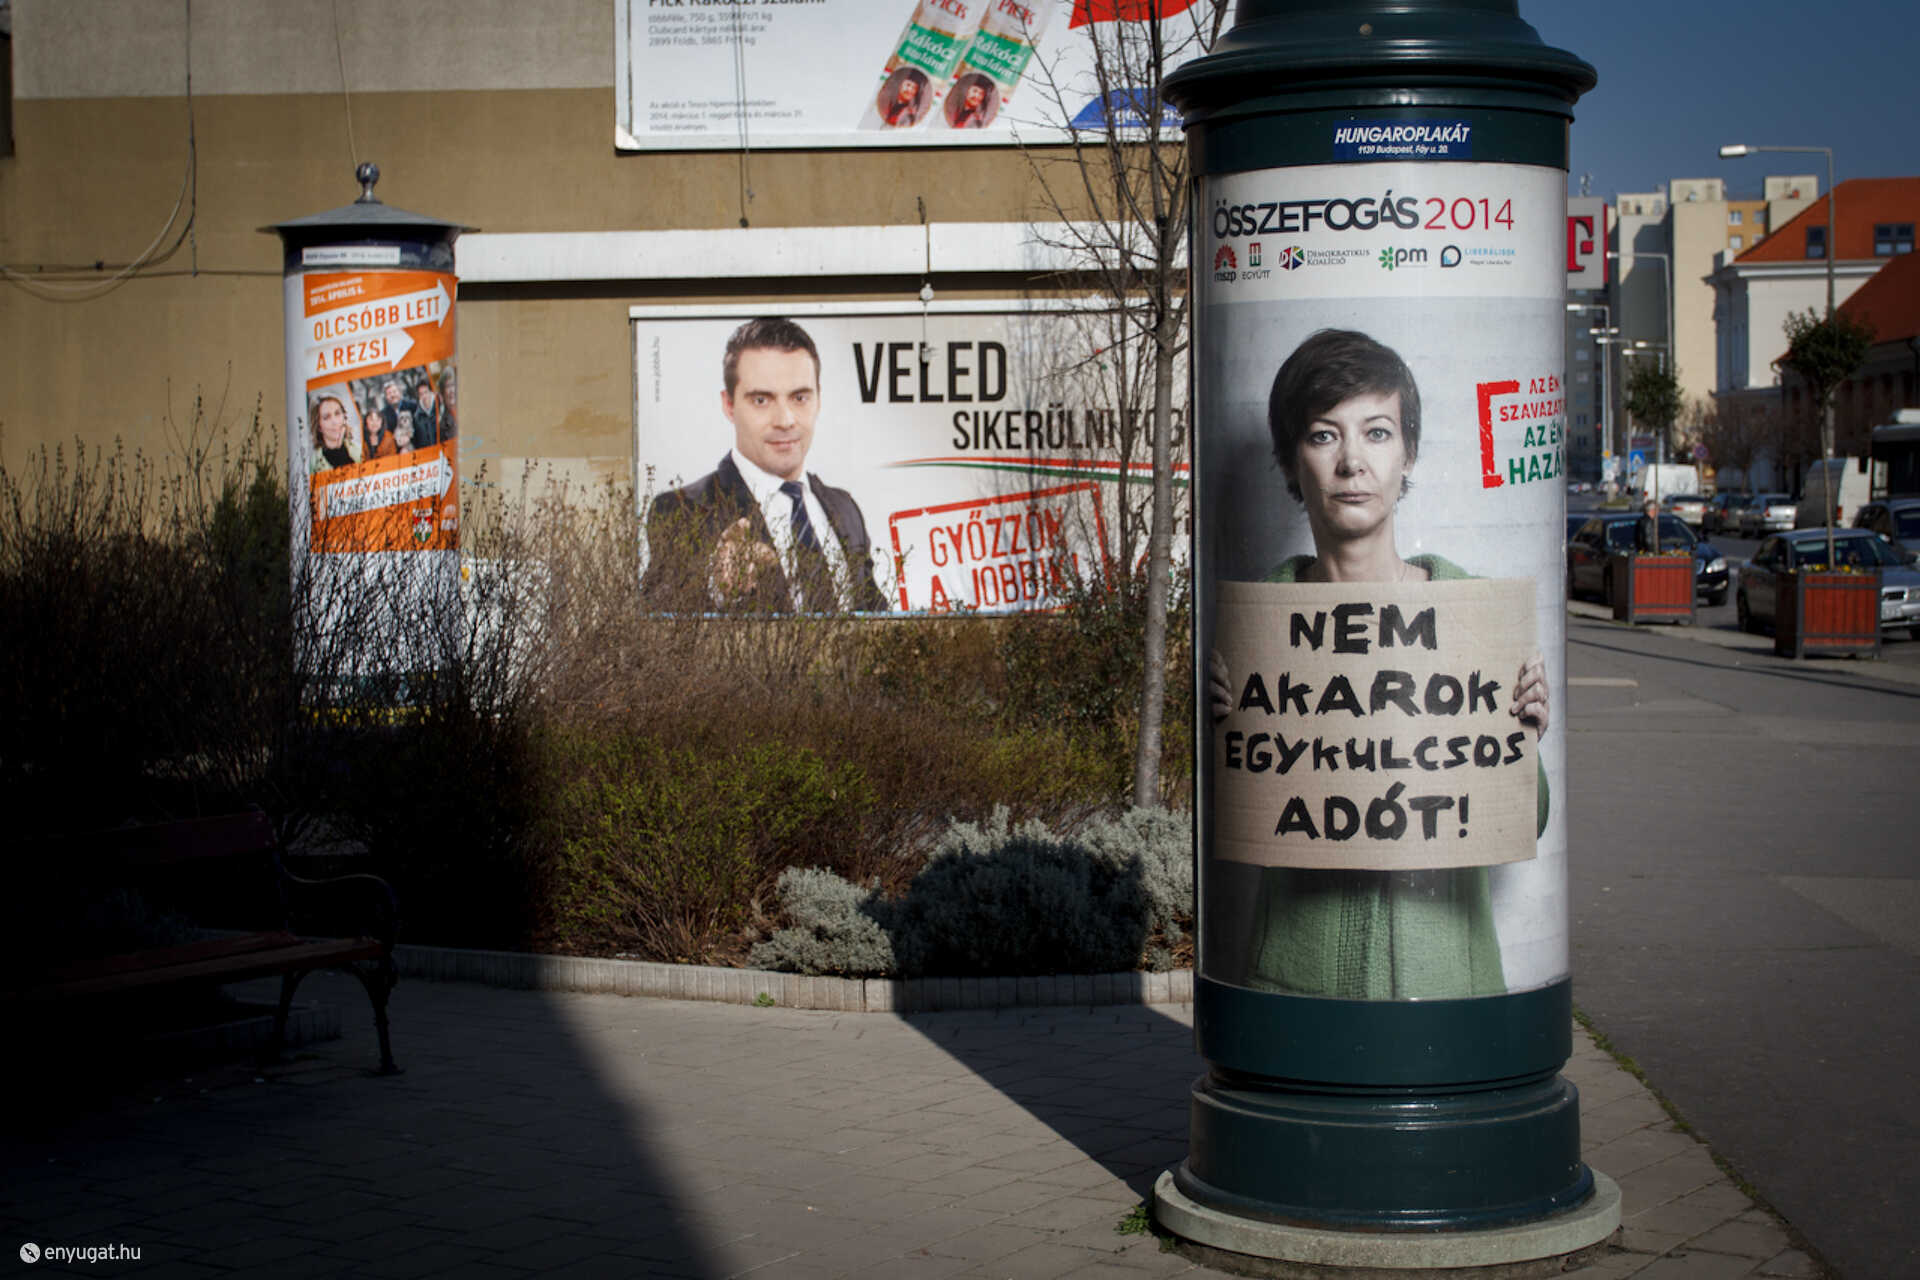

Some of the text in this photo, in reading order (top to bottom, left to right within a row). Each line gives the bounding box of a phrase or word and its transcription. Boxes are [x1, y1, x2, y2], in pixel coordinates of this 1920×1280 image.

[1335, 123, 1470, 144] HUNGAROPLAKÁT
[1214, 190, 1515, 240] ÖSSZEFOGÁS 2014
[1214, 271, 1236, 284] mszp
[1395, 248, 1428, 268] pm
[313, 295, 441, 342] OLCSÓBB LETT
[316, 337, 388, 372] A REZSI
[853, 341, 1008, 403] VELED
[1529, 378, 1546, 395] AZ
[1524, 424, 1547, 448] AZ
[1508, 445, 1565, 485] HAZÁ
[929, 504, 1067, 568] GYŐZZÖN
[929, 574, 951, 614] A
[1290, 603, 1438, 655] NEM
[1238, 669, 1502, 718] AKAROK
[1224, 731, 1526, 775] EGYKULCSOS
[1275, 781, 1470, 842] ADÓT!
